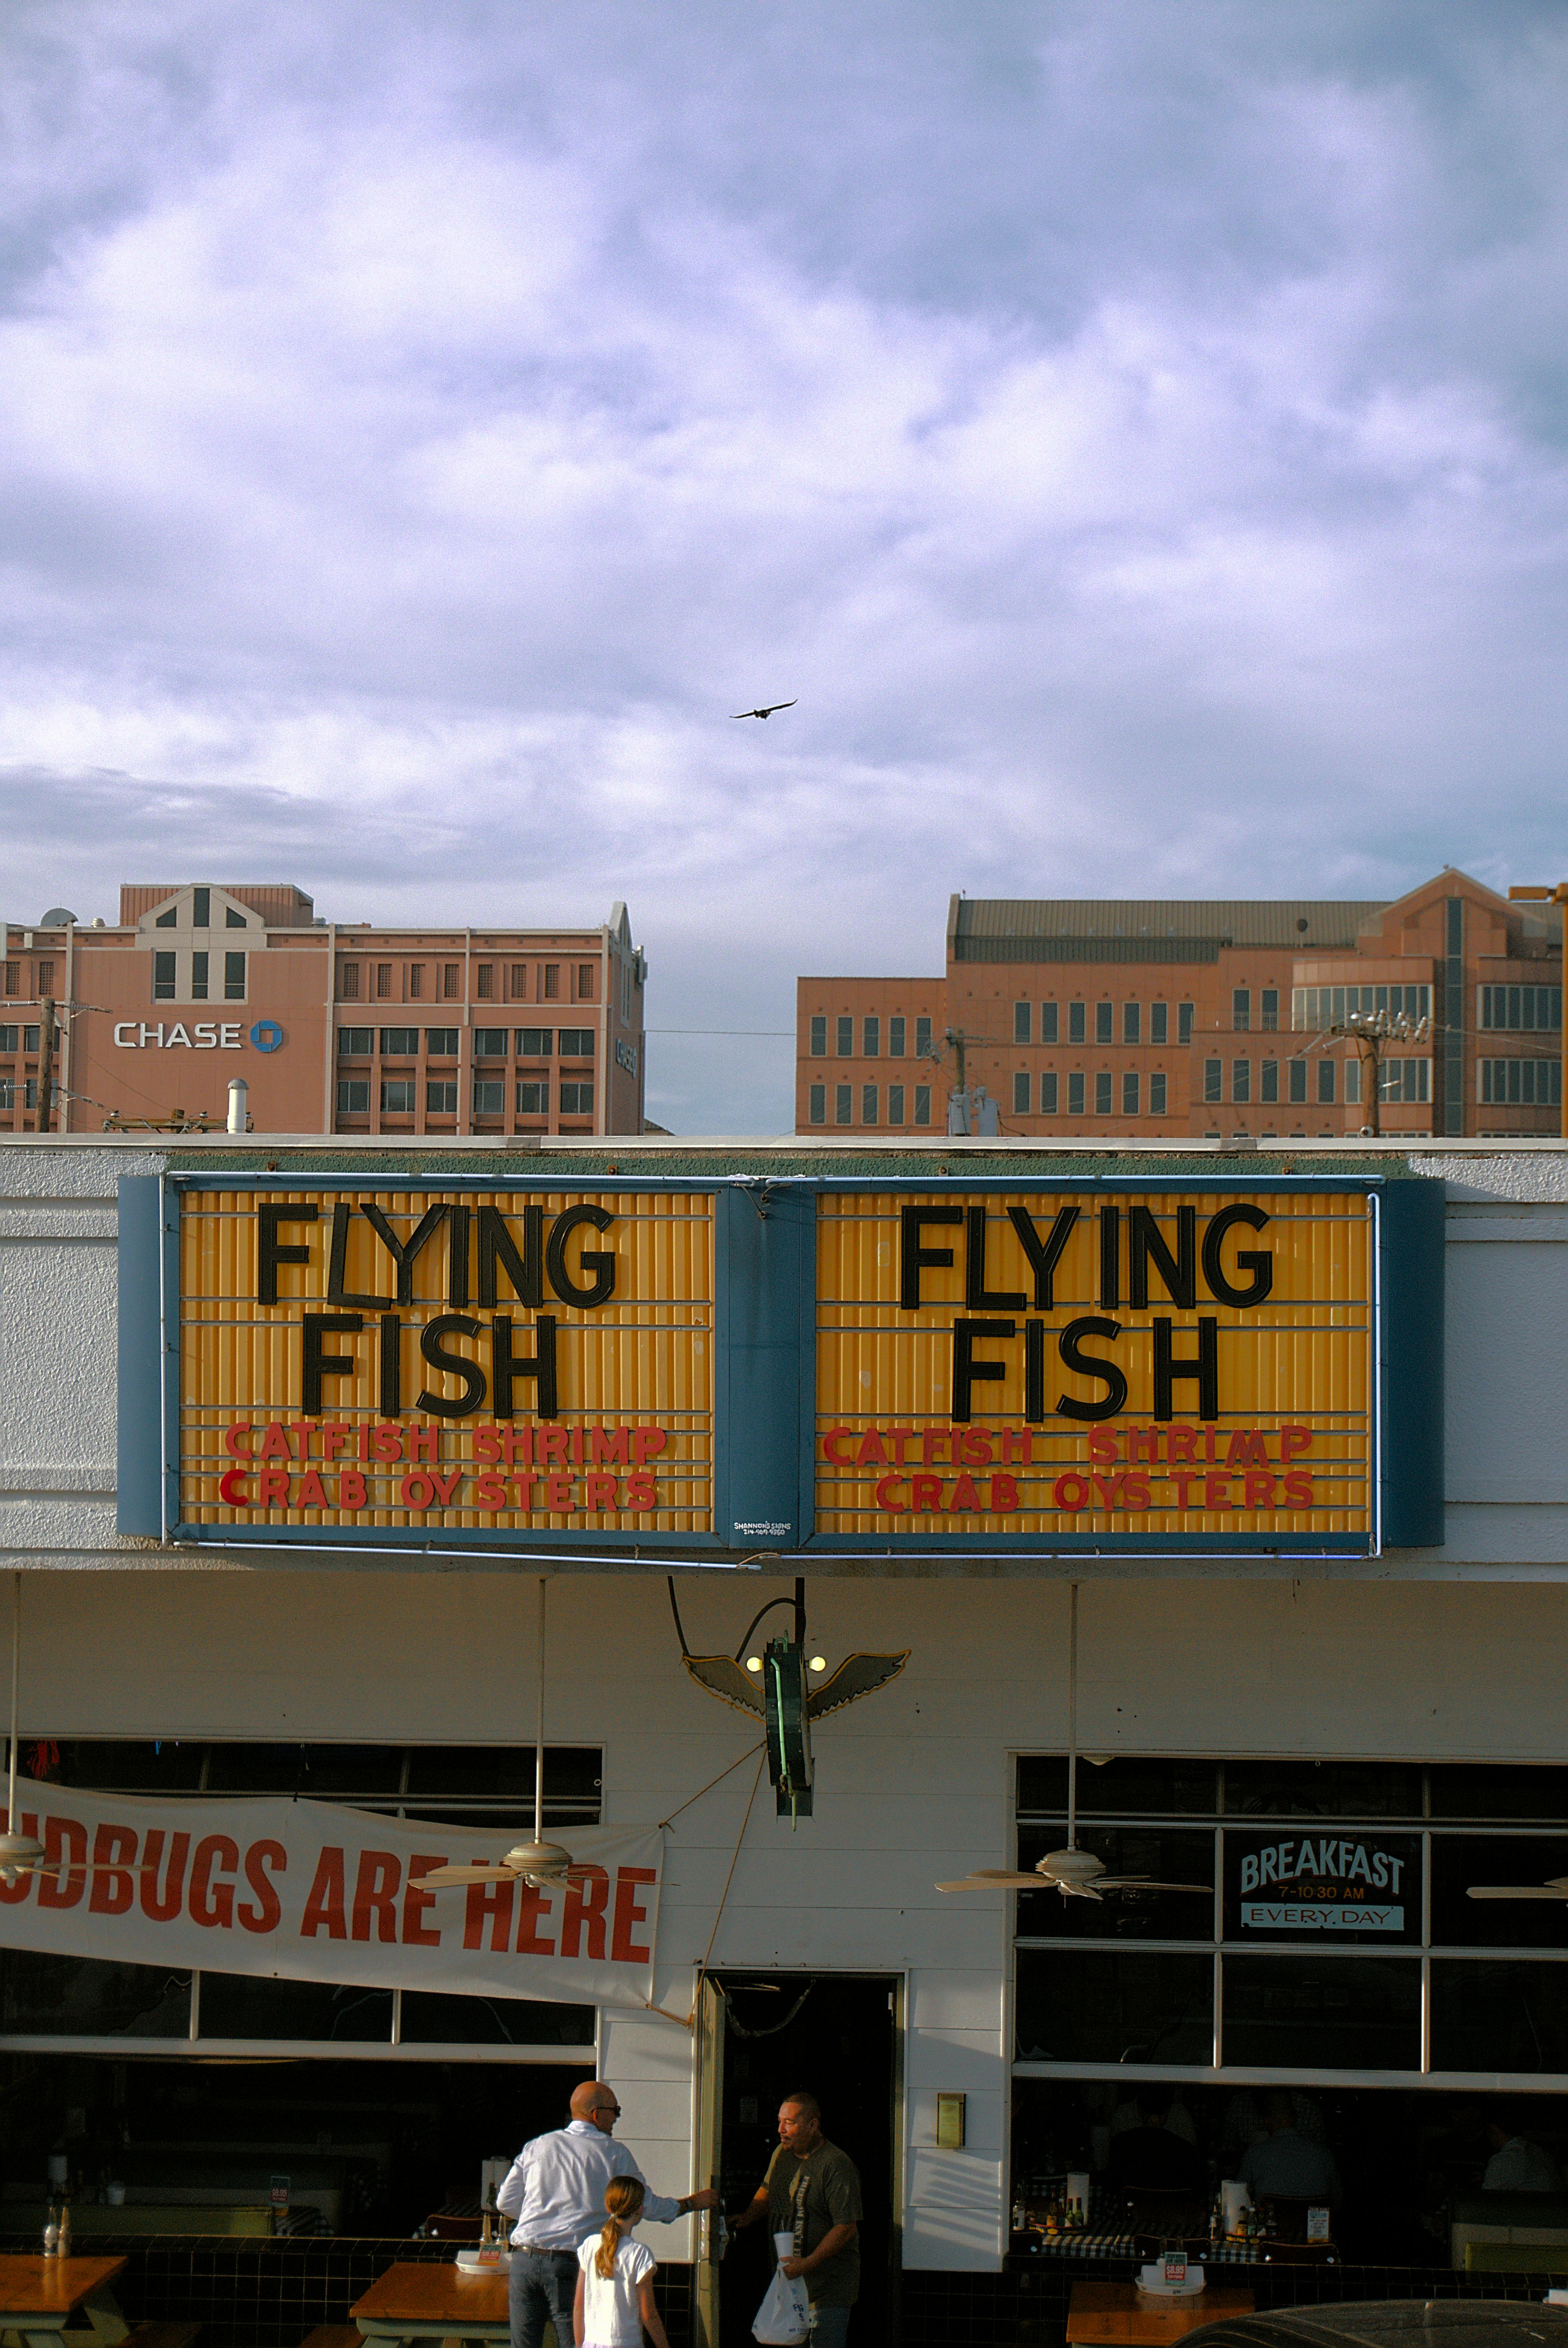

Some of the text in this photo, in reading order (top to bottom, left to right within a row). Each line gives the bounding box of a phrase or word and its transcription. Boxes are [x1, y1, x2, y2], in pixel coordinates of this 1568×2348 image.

[114, 1022, 242, 1048] CHASE
[258, 1203, 616, 1310] FLYING
[901, 1203, 1273, 1311] FLYING
[302, 1313, 558, 1419] FISH
[952, 1316, 1218, 1423] FISH
[225, 1422, 667, 1465] CATFISH SHRIMP
[823, 1425, 1312, 1468] CATFISH SHRIMP
[220, 1468, 657, 1513] CRAB OYSTERS
[876, 1471, 1314, 1513] CRAB OYSTERS
[734, 1521, 770, 1529] SHANNON'S
[1241, 1840, 1404, 1896] BREAKFAST
[300, 1846, 449, 1947] ARE
[462, 1859, 657, 1963] HERE
[1343, 1887, 1365, 1900] AM
[1251, 1908, 1391, 1924] EVERY DAY
[1166, 2265, 1184, 2275] $8.95
